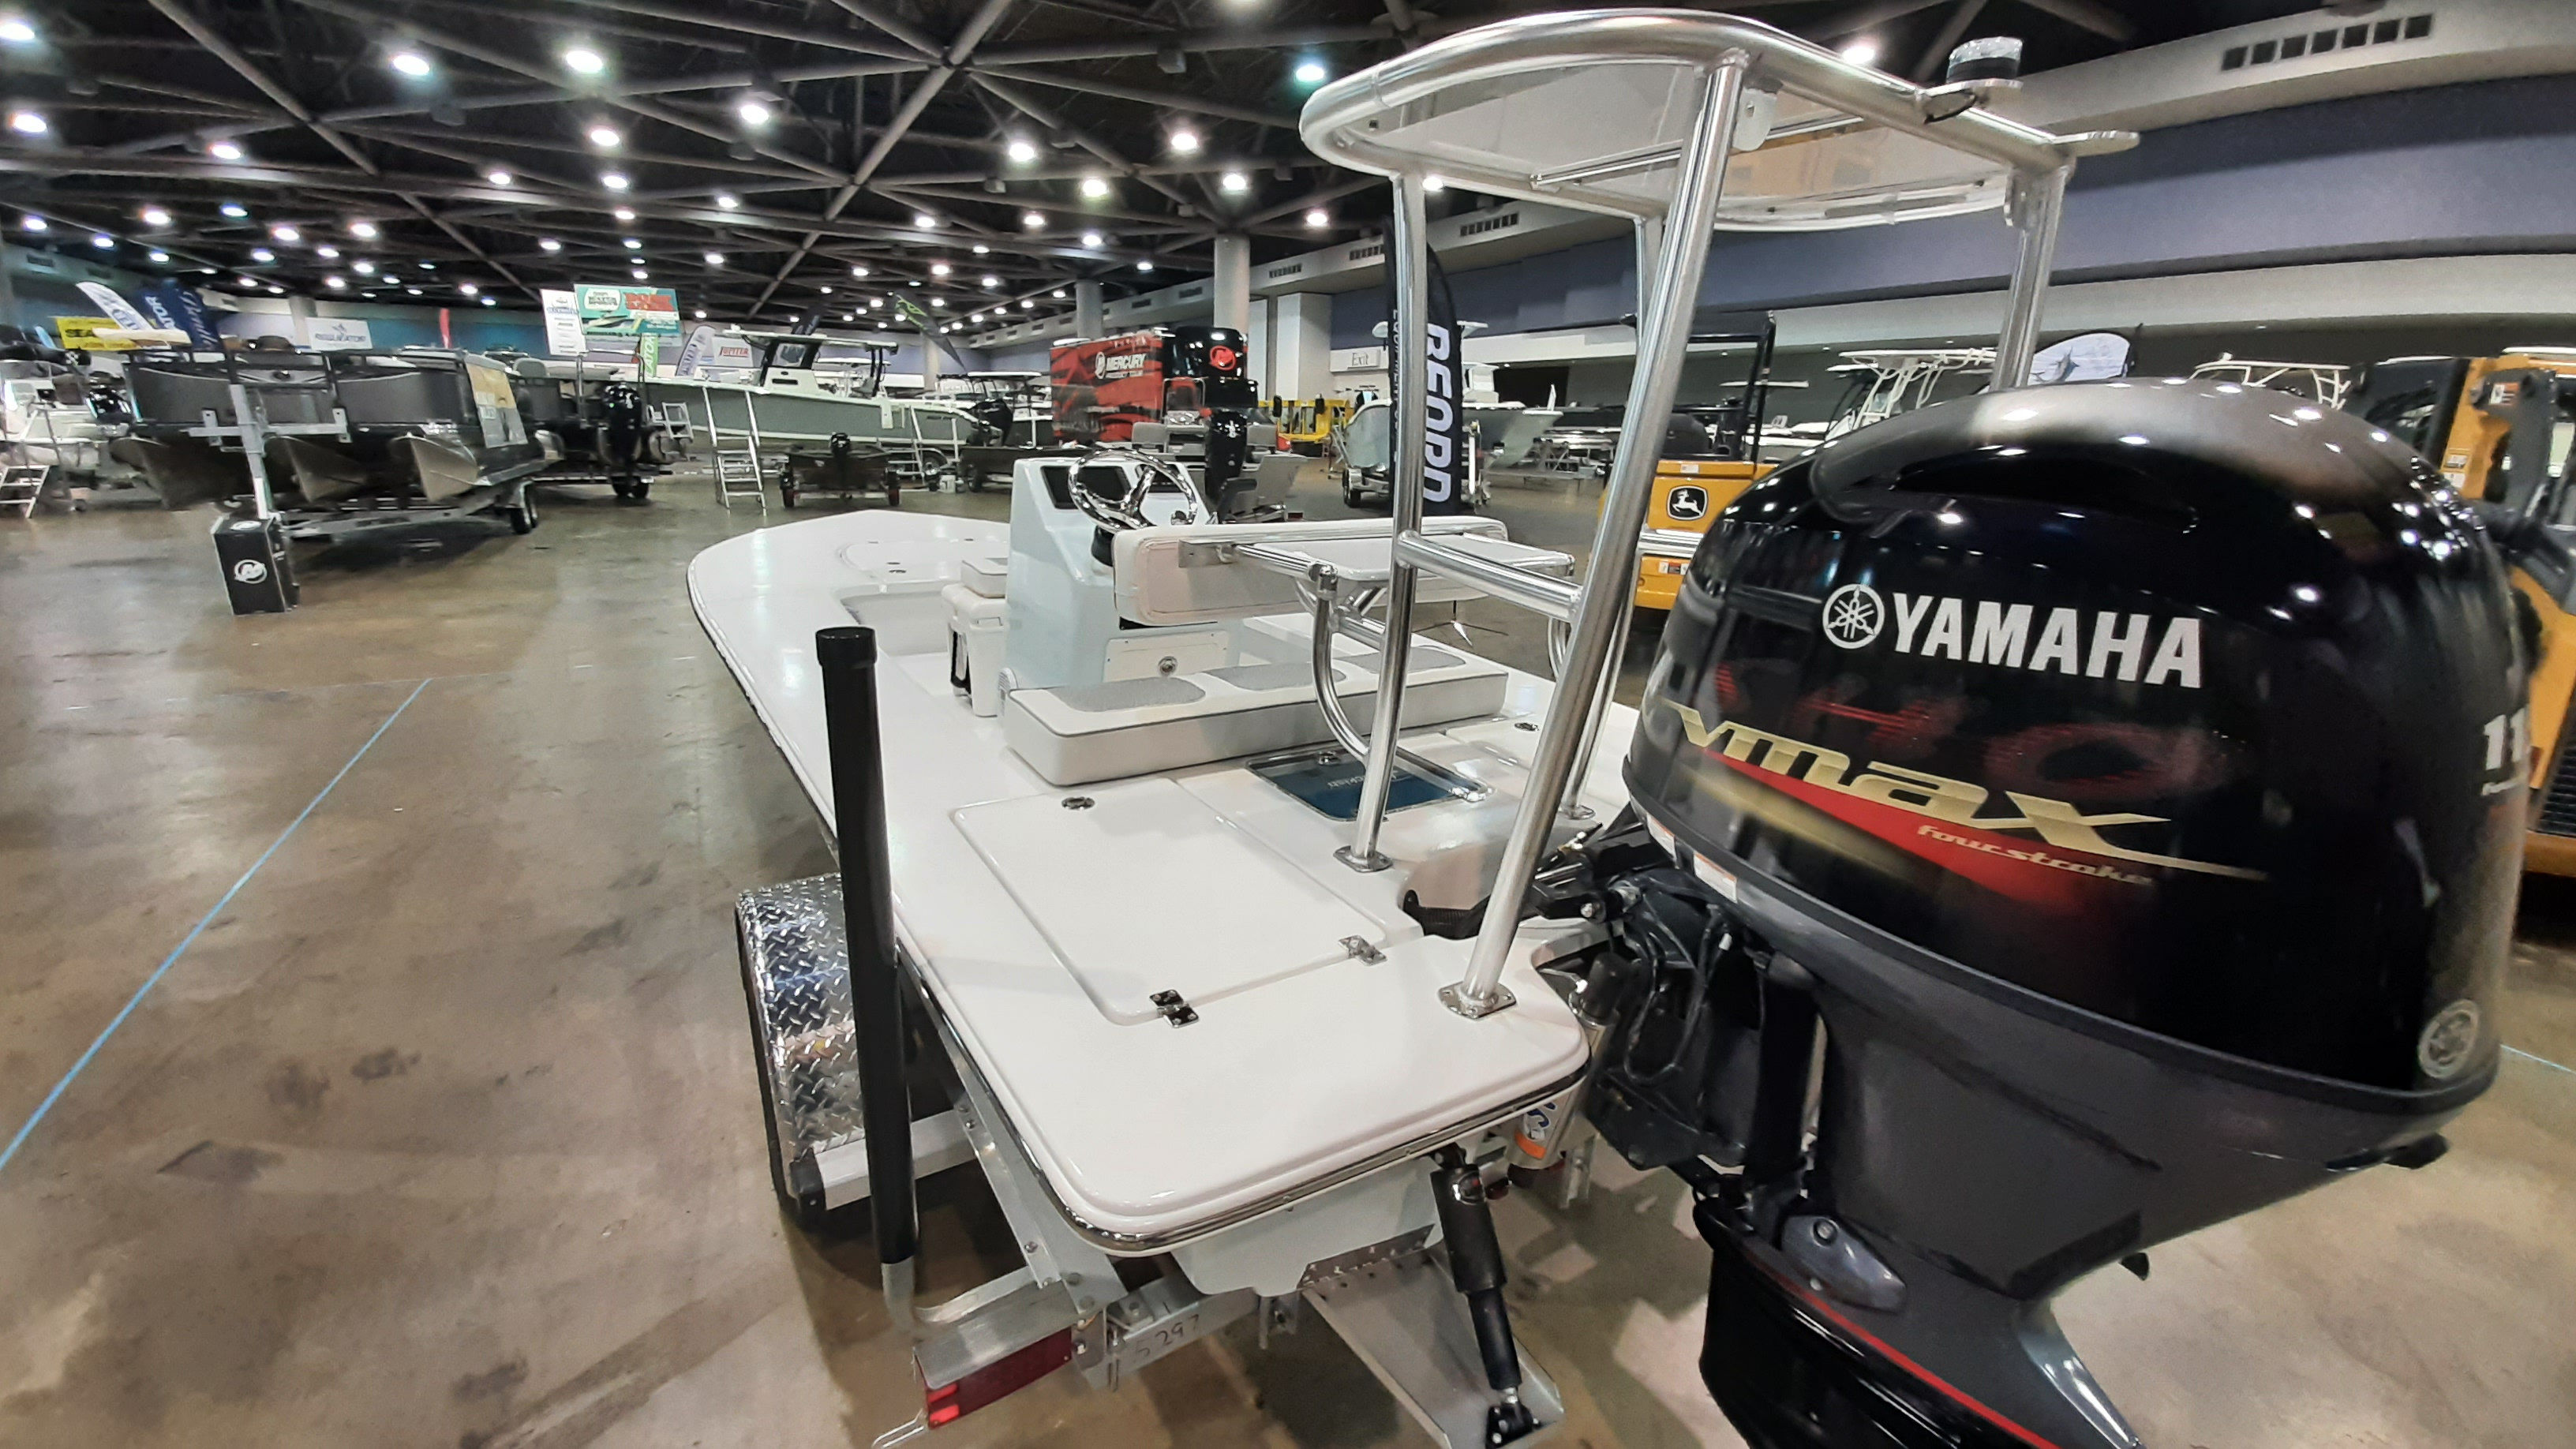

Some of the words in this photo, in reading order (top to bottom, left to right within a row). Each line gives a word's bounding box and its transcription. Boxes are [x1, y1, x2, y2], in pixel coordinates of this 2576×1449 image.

[1106, 353, 1147, 372] MERCURY
[1352, 352, 1369, 366] Exit
[1893, 592, 2202, 689] YAMAHA
